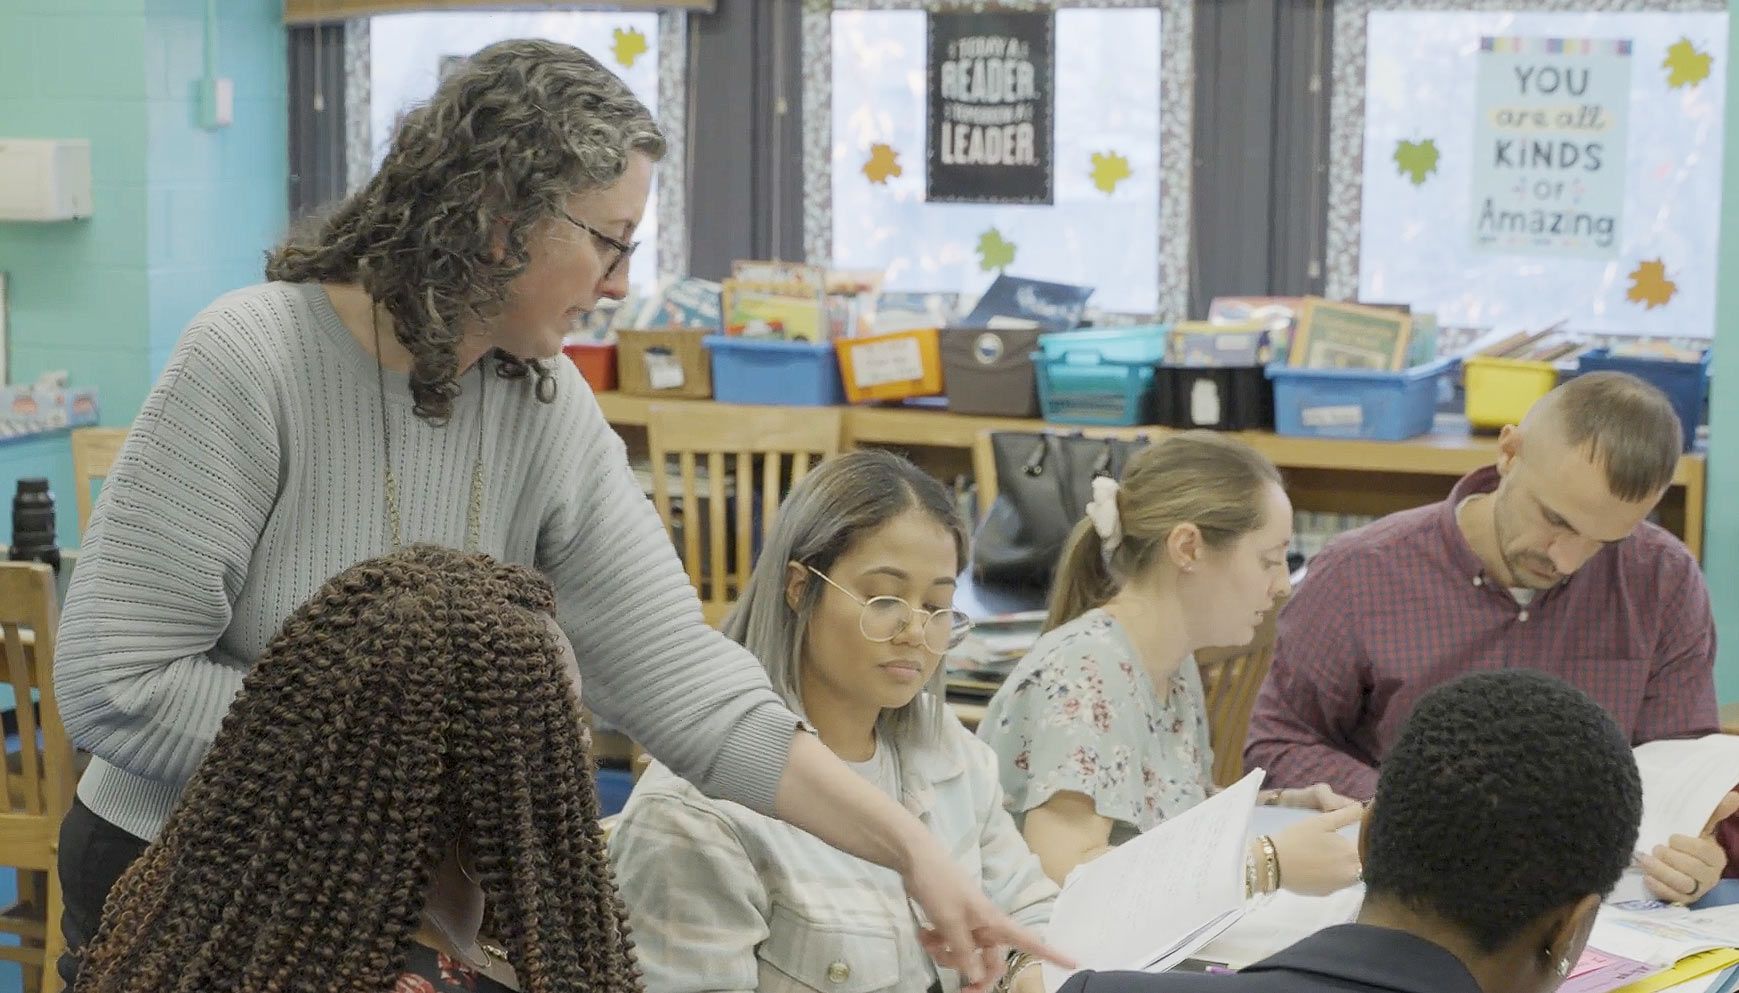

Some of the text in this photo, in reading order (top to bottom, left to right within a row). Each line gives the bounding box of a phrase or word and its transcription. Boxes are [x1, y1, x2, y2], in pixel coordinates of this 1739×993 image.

[1515, 66, 1588, 96] YOU
[1496, 104, 1606, 129] are all
[1478, 198, 1614, 248] Amazing
